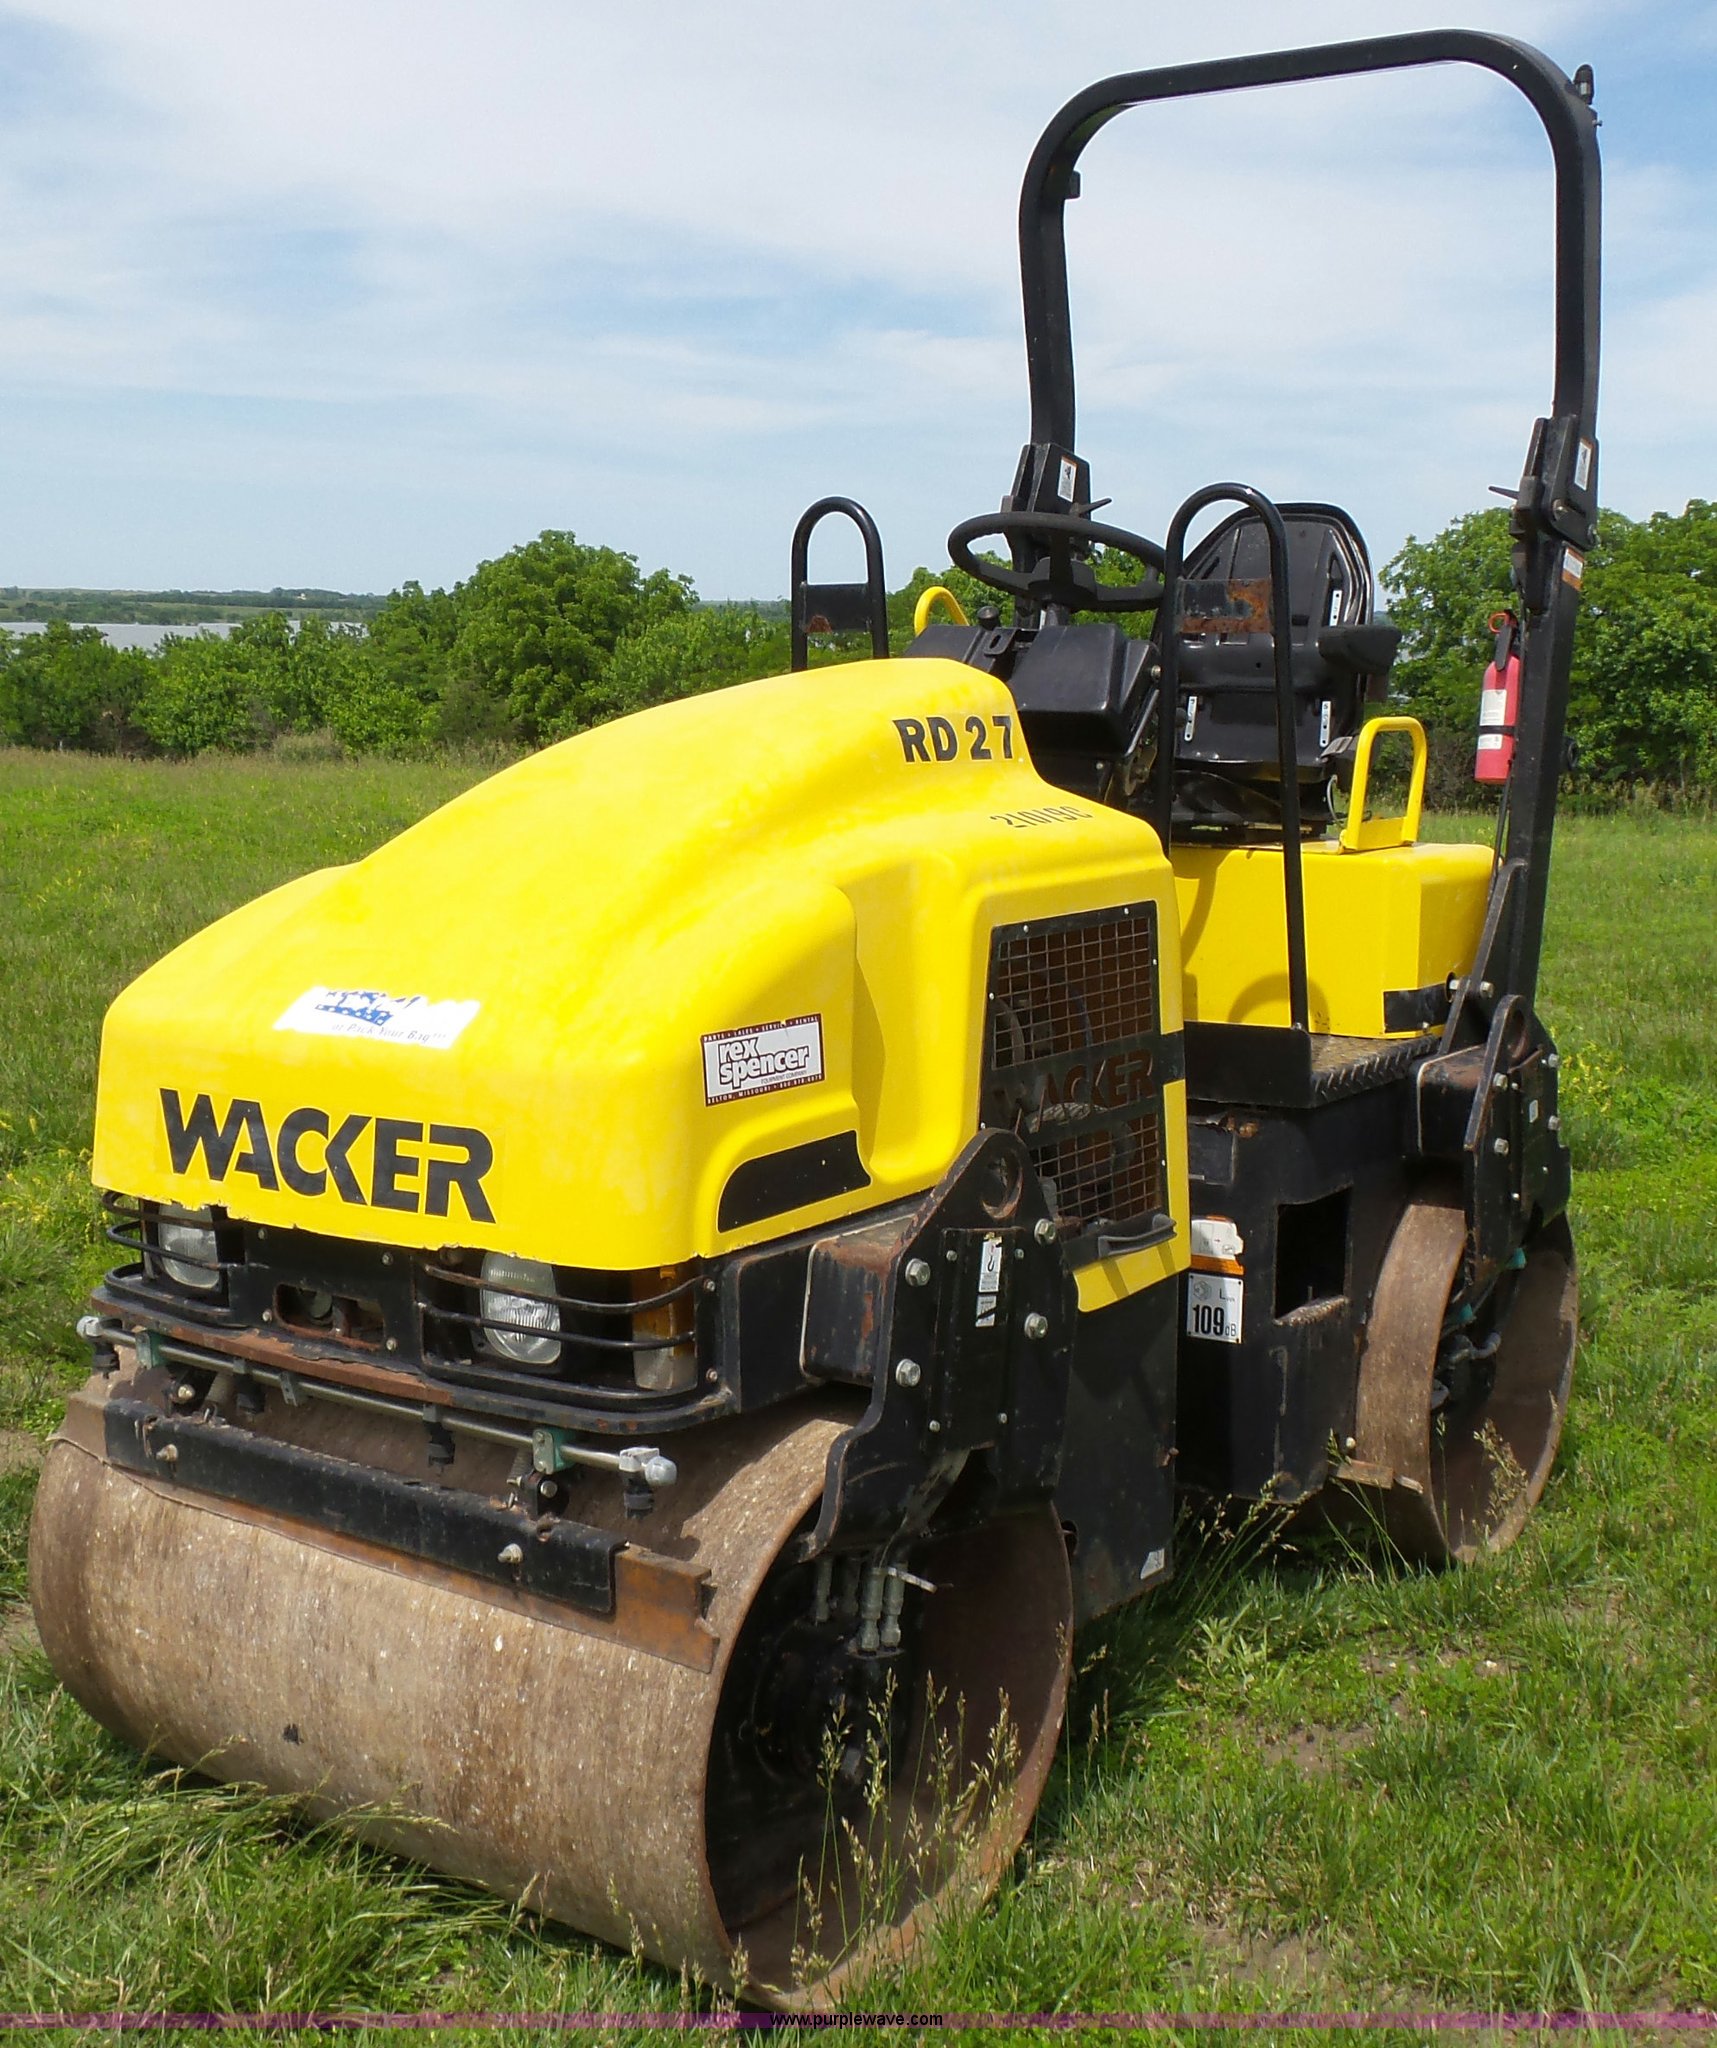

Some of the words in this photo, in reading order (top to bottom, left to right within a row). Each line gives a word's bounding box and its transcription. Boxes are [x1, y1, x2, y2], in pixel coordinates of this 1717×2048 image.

[892, 716, 958, 762] RD
[965, 715, 1013, 760] 27
[718, 1037, 759, 1064] rex
[719, 1045, 810, 1090] spencer
[159, 1087, 497, 1225] WACKER
[1192, 1303, 1225, 1337] 109
